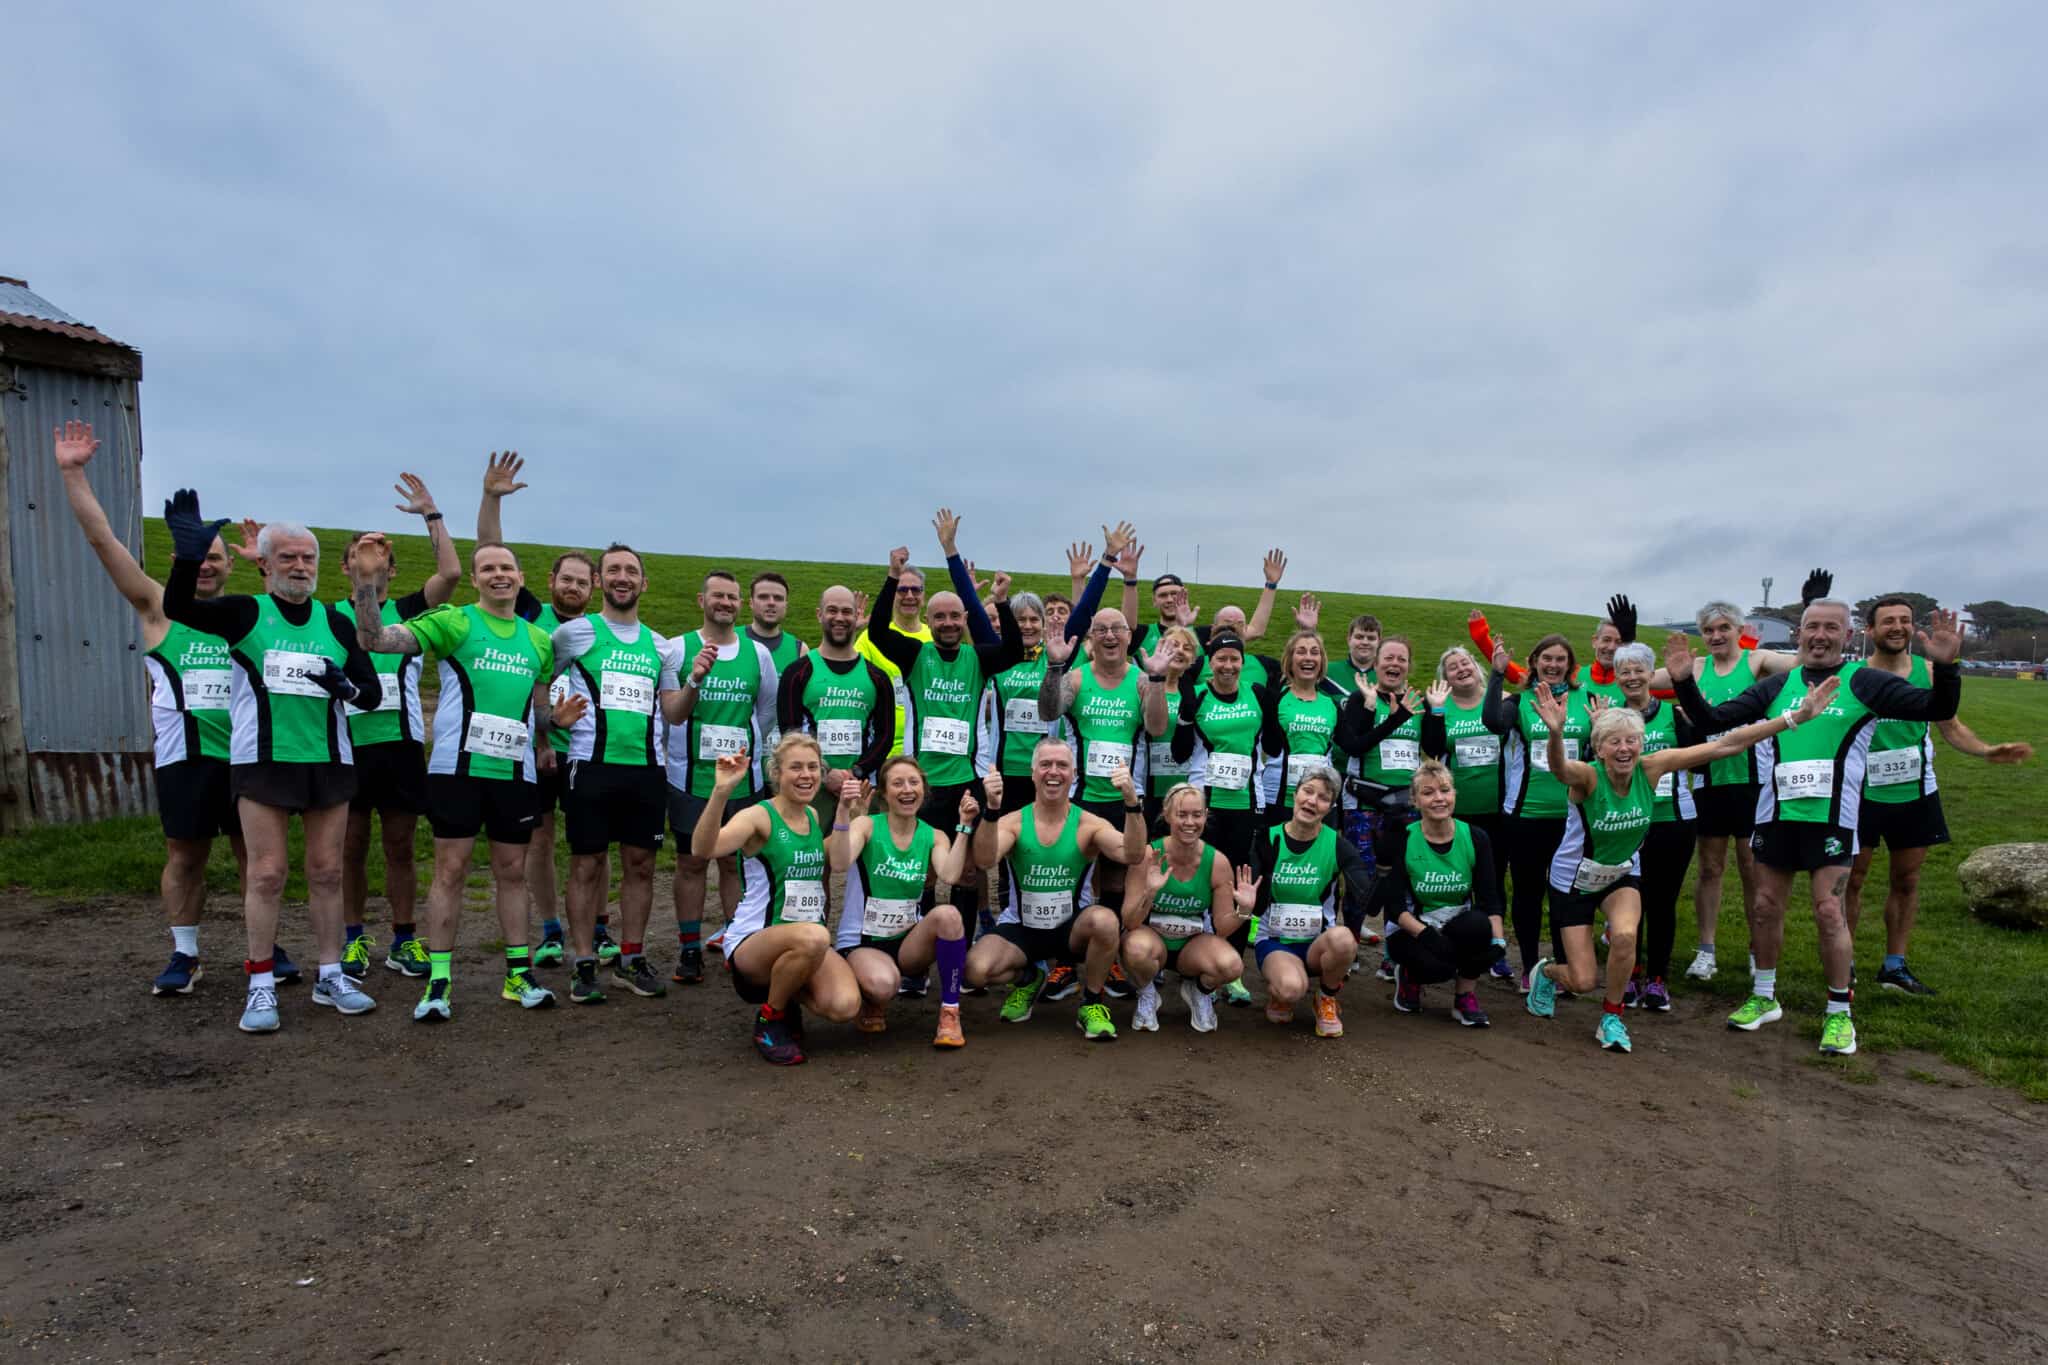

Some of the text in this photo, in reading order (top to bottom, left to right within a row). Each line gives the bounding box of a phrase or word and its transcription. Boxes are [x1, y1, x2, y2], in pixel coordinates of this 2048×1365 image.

[188, 641, 229, 657] Hayl
[179, 653, 232, 666] Runne
[484, 647, 529, 665] Hayle
[610, 650, 652, 665] Hayle
[472, 658, 534, 678] Runners
[601, 659, 657, 678] Runners
[705, 677, 747, 691] Hayle
[931, 678, 965, 692] Hayle
[1003, 677, 1042, 687] Runner
[204, 684, 231, 695] 774
[619, 687, 640, 698] 539
[698, 689, 752, 703] Runners
[825, 686, 864, 700] Hayle
[924, 689, 971, 703] Runners
[819, 697, 868, 710] Runners
[1089, 696, 1126, 710] Hayle
[1212, 704, 1249, 713] Hayle
[1020, 711, 1032, 720] 49
[1082, 706, 1132, 719] Runners
[1204, 710, 1257, 722] Runners
[1091, 719, 1125, 727] TREVOR
[1294, 714, 1327, 725] Hayle
[1455, 716, 1483, 728] Hayl
[1289, 722, 1331, 735] Runners
[489, 731, 512, 744] 179
[831, 732, 850, 742] 806
[935, 730, 954, 741] 748
[716, 738, 736, 749] 378
[1101, 754, 1120, 765] 725
[1218, 766, 1238, 776] 578
[1884, 761, 1906, 773] 332
[1791, 773, 1814, 785] 859
[1593, 815, 1650, 832] Runners
[1030, 864, 1070, 878] Hayle
[1279, 862, 1318, 876] Hayle
[1023, 875, 1076, 887] Runners
[1424, 871, 1462, 884] Hayle
[1415, 880, 1469, 893] Runners
[801, 896, 819, 906] 809
[1158, 893, 1202, 908] Hayle
[1036, 906, 1057, 916] 387
[881, 913, 904, 924] 772
[1285, 917, 1306, 927] 235
